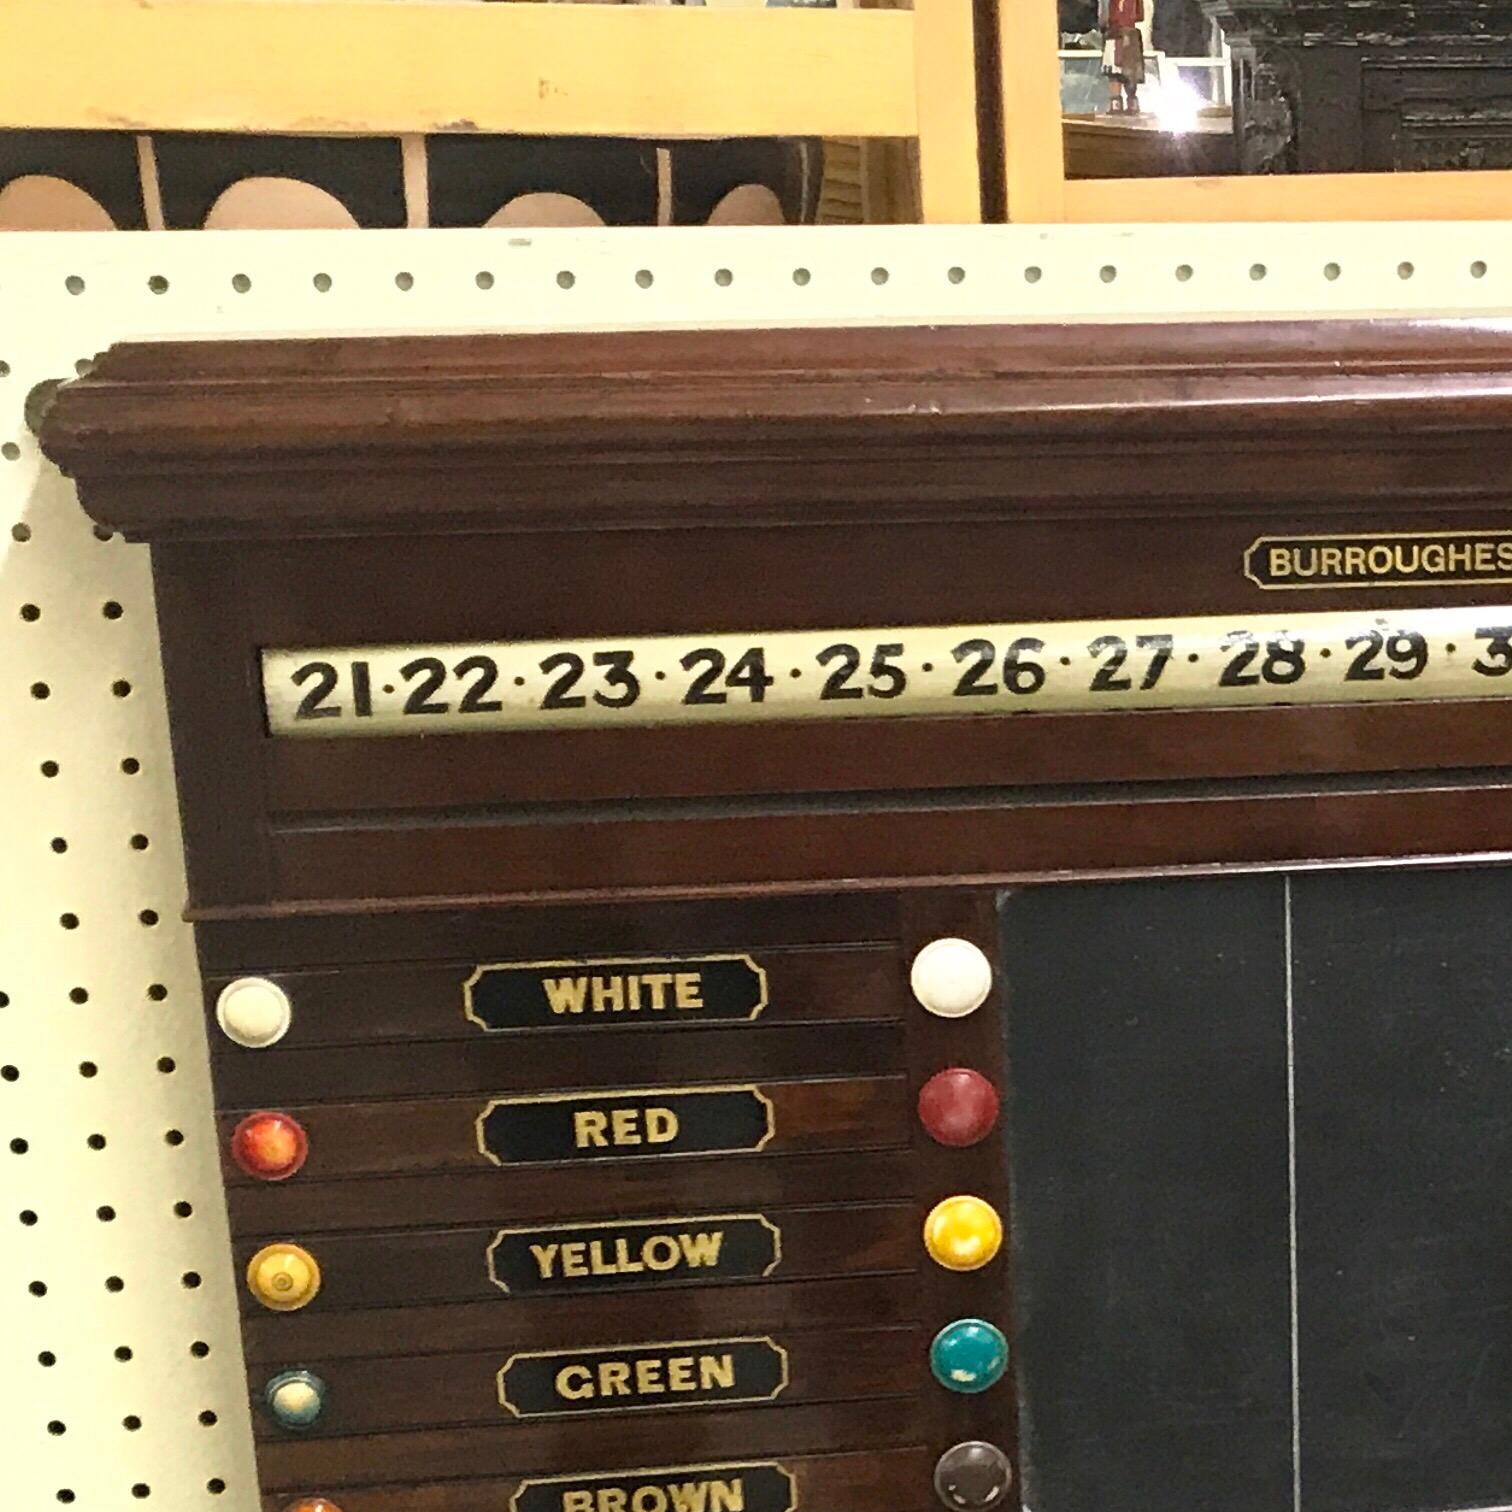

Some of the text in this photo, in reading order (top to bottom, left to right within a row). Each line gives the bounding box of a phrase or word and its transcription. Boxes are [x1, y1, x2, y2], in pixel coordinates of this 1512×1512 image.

[291, 661, 373, 721] 21
[400, 656, 503, 715] 22
[540, 651, 642, 710] 23
[680, 647, 773, 705] 24
[816, 642, 907, 700] 25
[951, 638, 1045, 697] 26
[1088, 634, 1175, 692] 27
[1218, 629, 1307, 687] 28
[1345, 626, 1428, 683] 29
[542, 973, 704, 1014] WHITE
[574, 1108, 679, 1147] RED
[529, 1232, 723, 1279] YELLOW
[555, 1355, 735, 1400] GREEN
